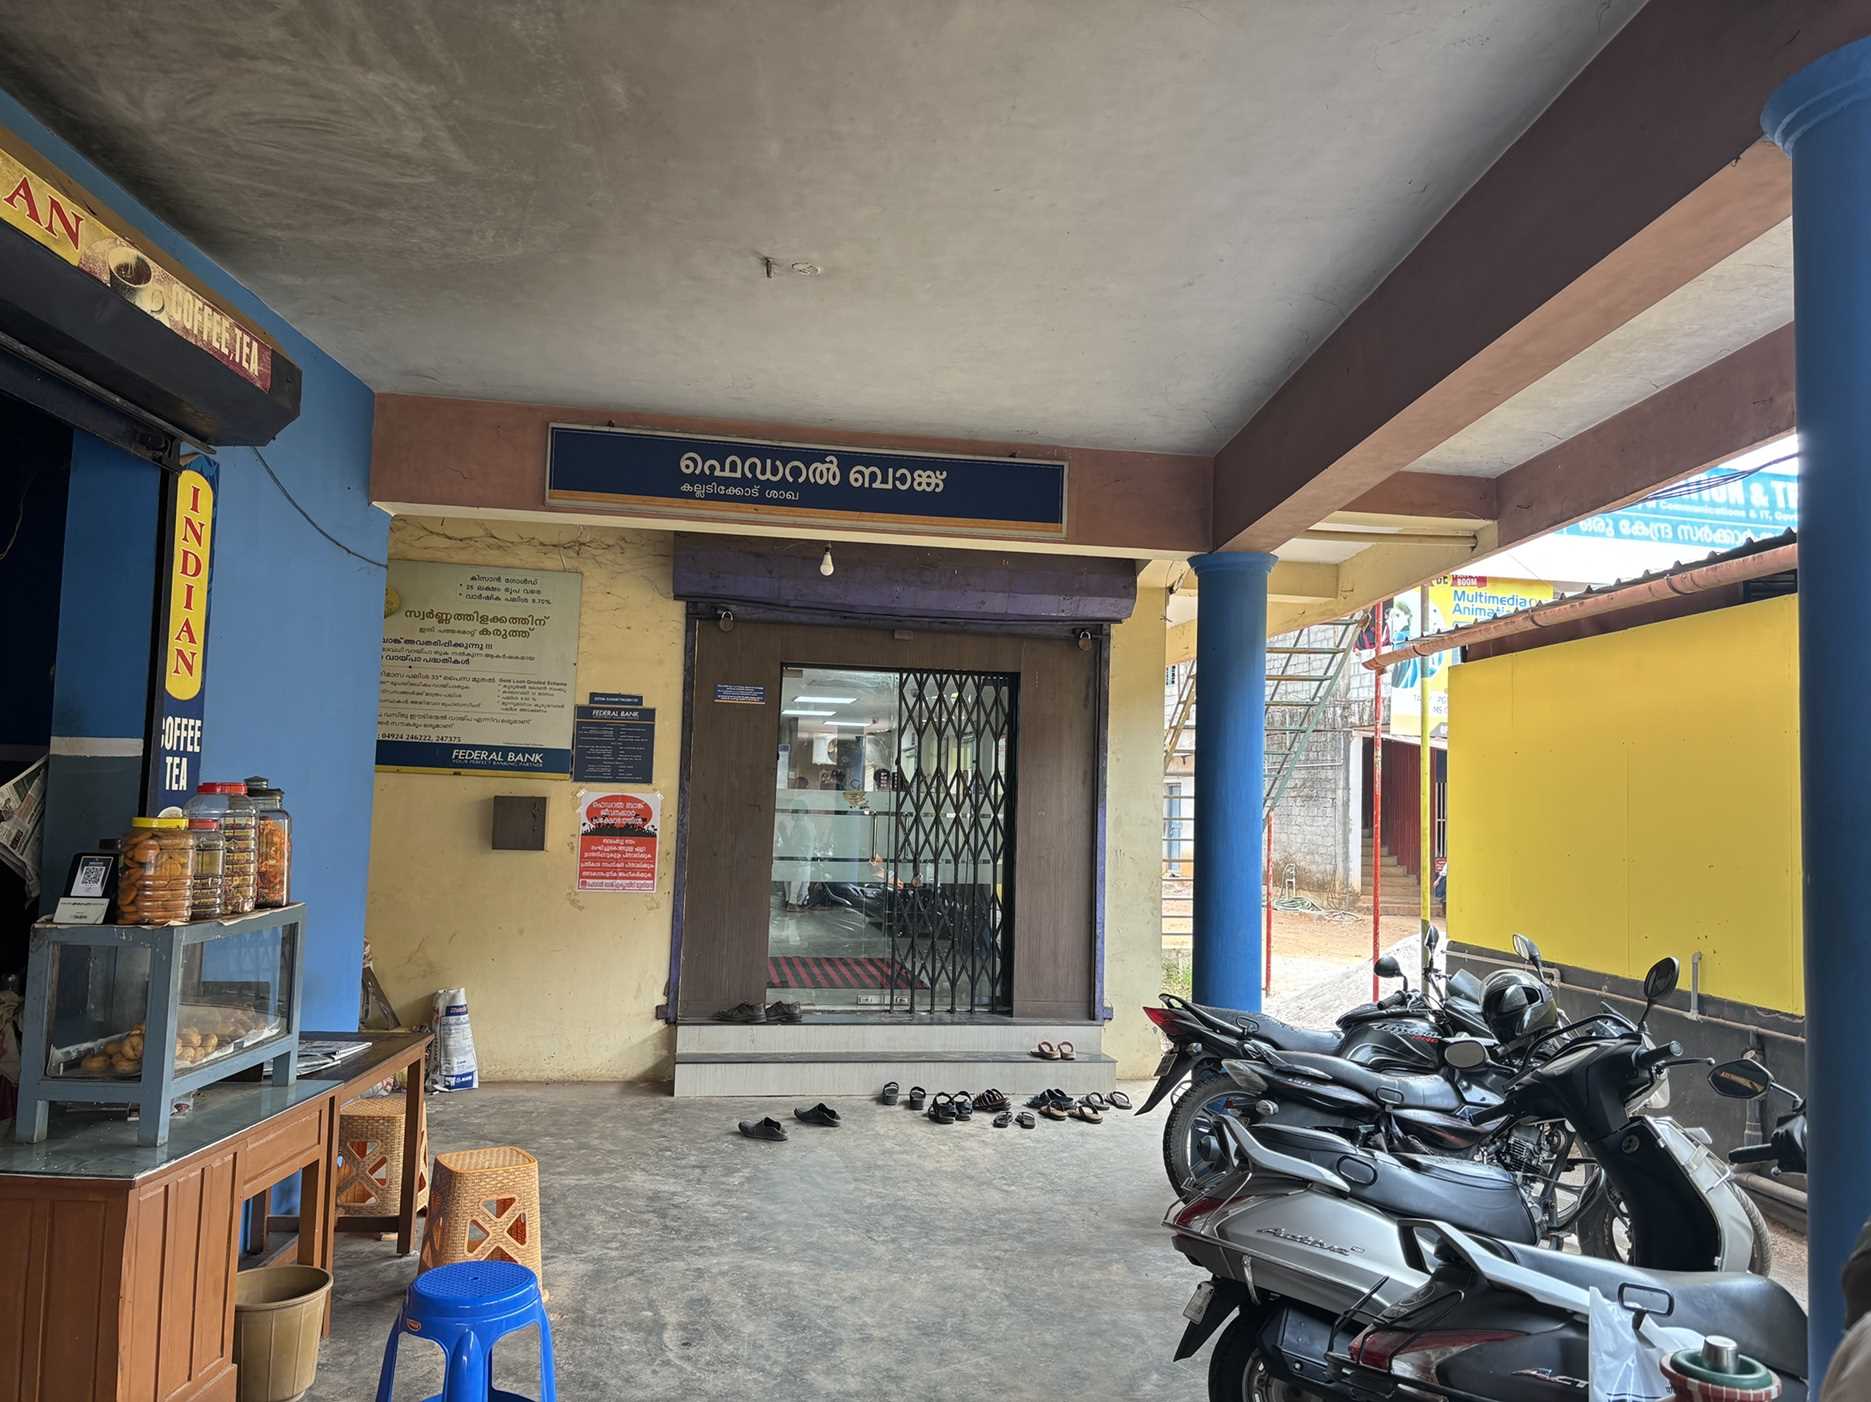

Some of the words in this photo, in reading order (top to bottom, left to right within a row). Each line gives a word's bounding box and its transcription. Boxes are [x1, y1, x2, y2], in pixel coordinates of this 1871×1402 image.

[679, 452, 841, 486] ഫെഡറൽ
[850, 464, 948, 493] ബാങ്ക്
[765, 488, 800, 501] ശാഖ
[172, 484, 206, 679] INDIAN
[1452, 589, 1528, 608] Multimedia
[478, 627, 536, 640] കരുത്ത്
[591, 709, 619, 717] FEDERAL
[620, 710, 640, 718] BANK
[451, 748, 504, 762] FEDERAL
[507, 751, 544, 764] BANK
[165, 757, 188, 791] TEA
